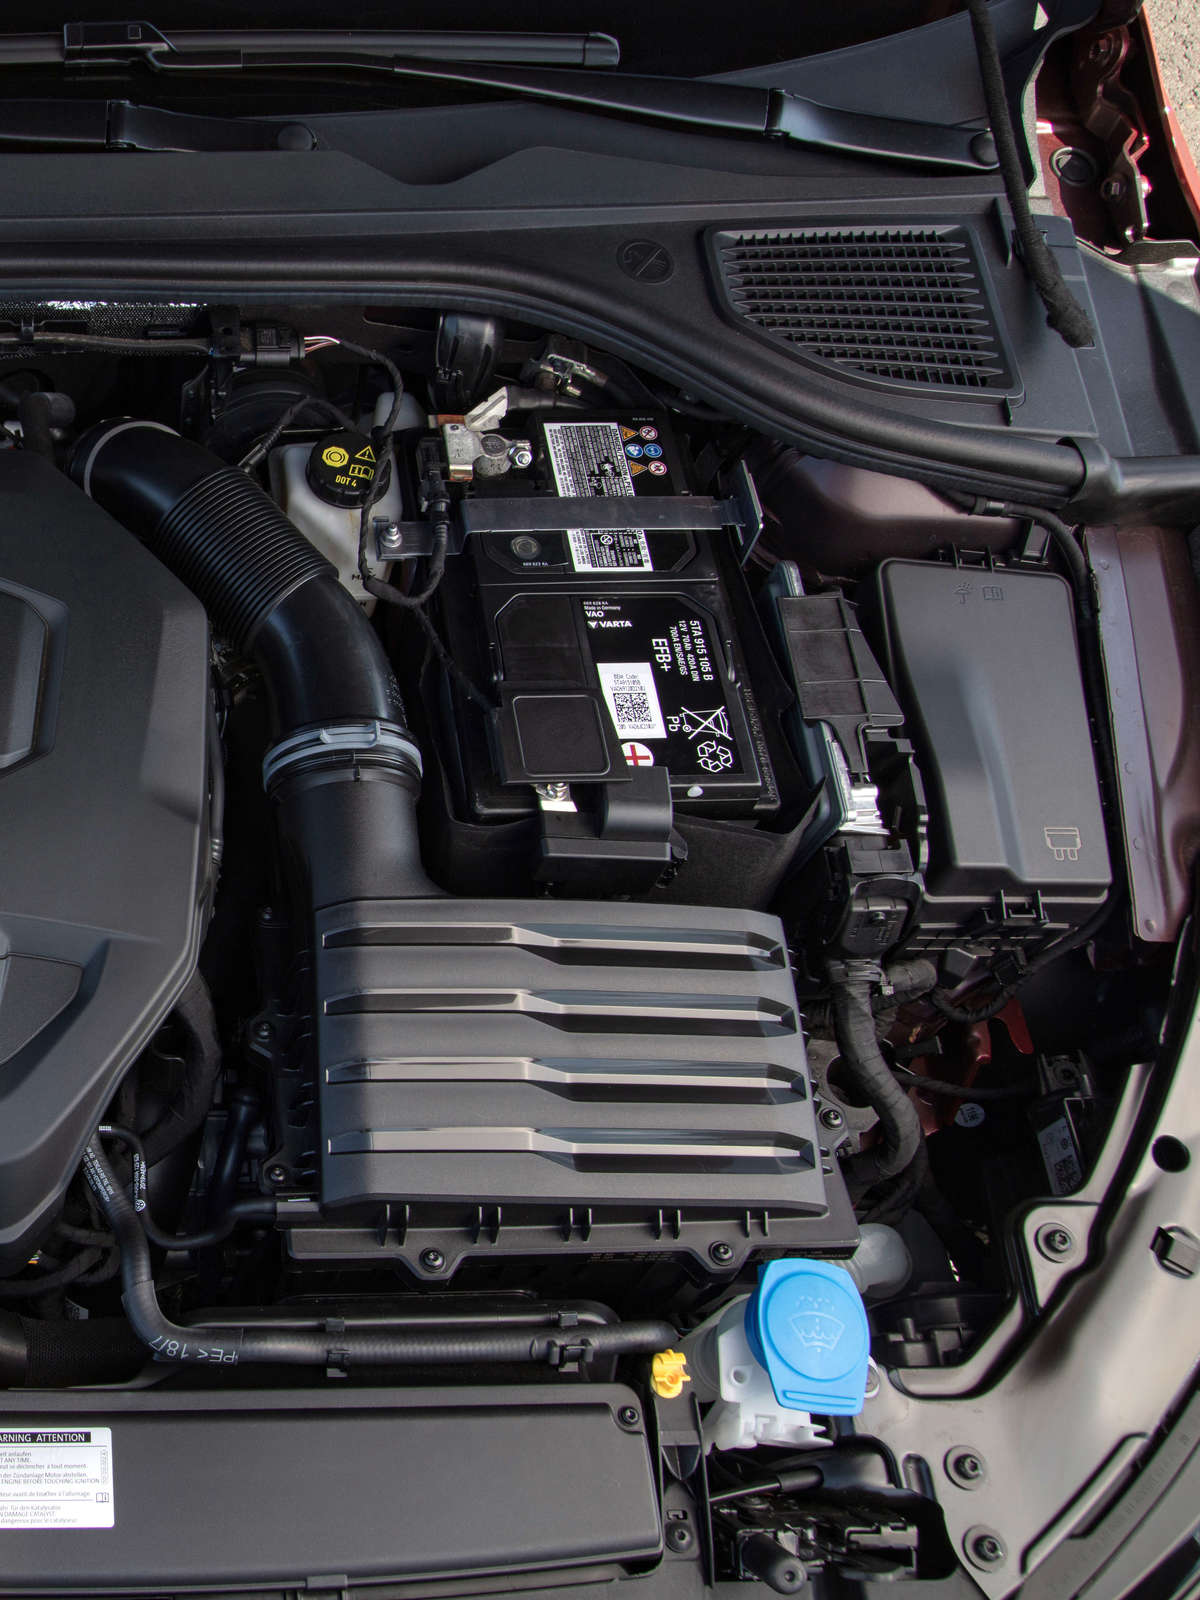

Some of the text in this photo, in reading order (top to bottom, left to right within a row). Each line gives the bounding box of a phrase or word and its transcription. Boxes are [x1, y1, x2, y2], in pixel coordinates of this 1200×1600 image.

[336, 475, 357, 487] DOT 4
[585, 610, 604, 618] VAO
[600, 620, 632, 628] VARTA
[690, 620, 702, 636] 5TA
[670, 626, 680, 642] 700A
[678, 620, 700, 682] 12V 70Ah 420A DIN
[694, 638, 706, 654] 915
[652, 638, 672, 672] EFB+
[699, 656, 712, 672] 105
[666, 716, 682, 732] Pb
[36, 1433, 85, 1442] ATTENTION
